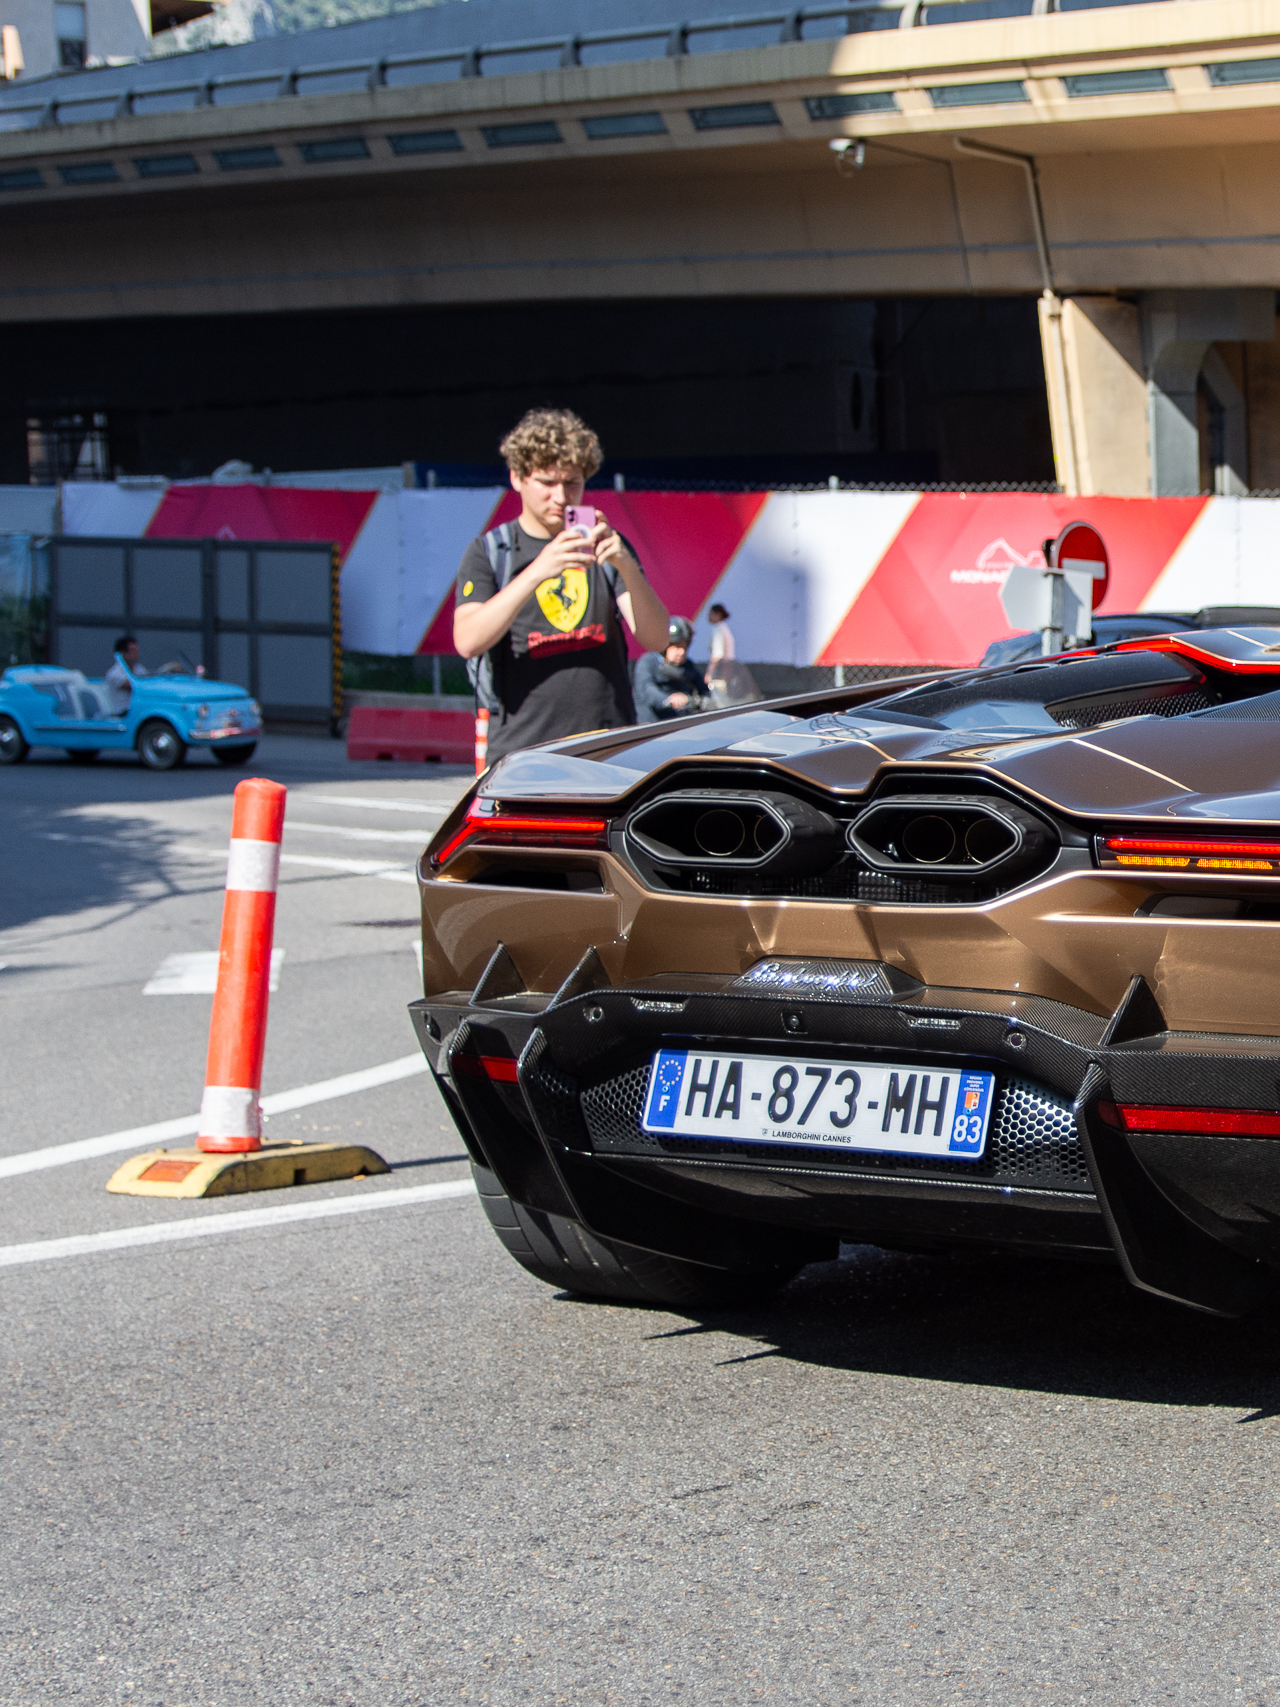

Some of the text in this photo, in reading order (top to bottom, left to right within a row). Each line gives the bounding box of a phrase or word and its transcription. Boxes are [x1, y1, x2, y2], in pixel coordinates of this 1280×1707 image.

[658, 1095, 670, 1111] F
[685, 1058, 950, 1136] HA-873-MH
[772, 1130, 851, 1143] LAMBORGHINI CANNES
[953, 1115, 982, 1143] 83
